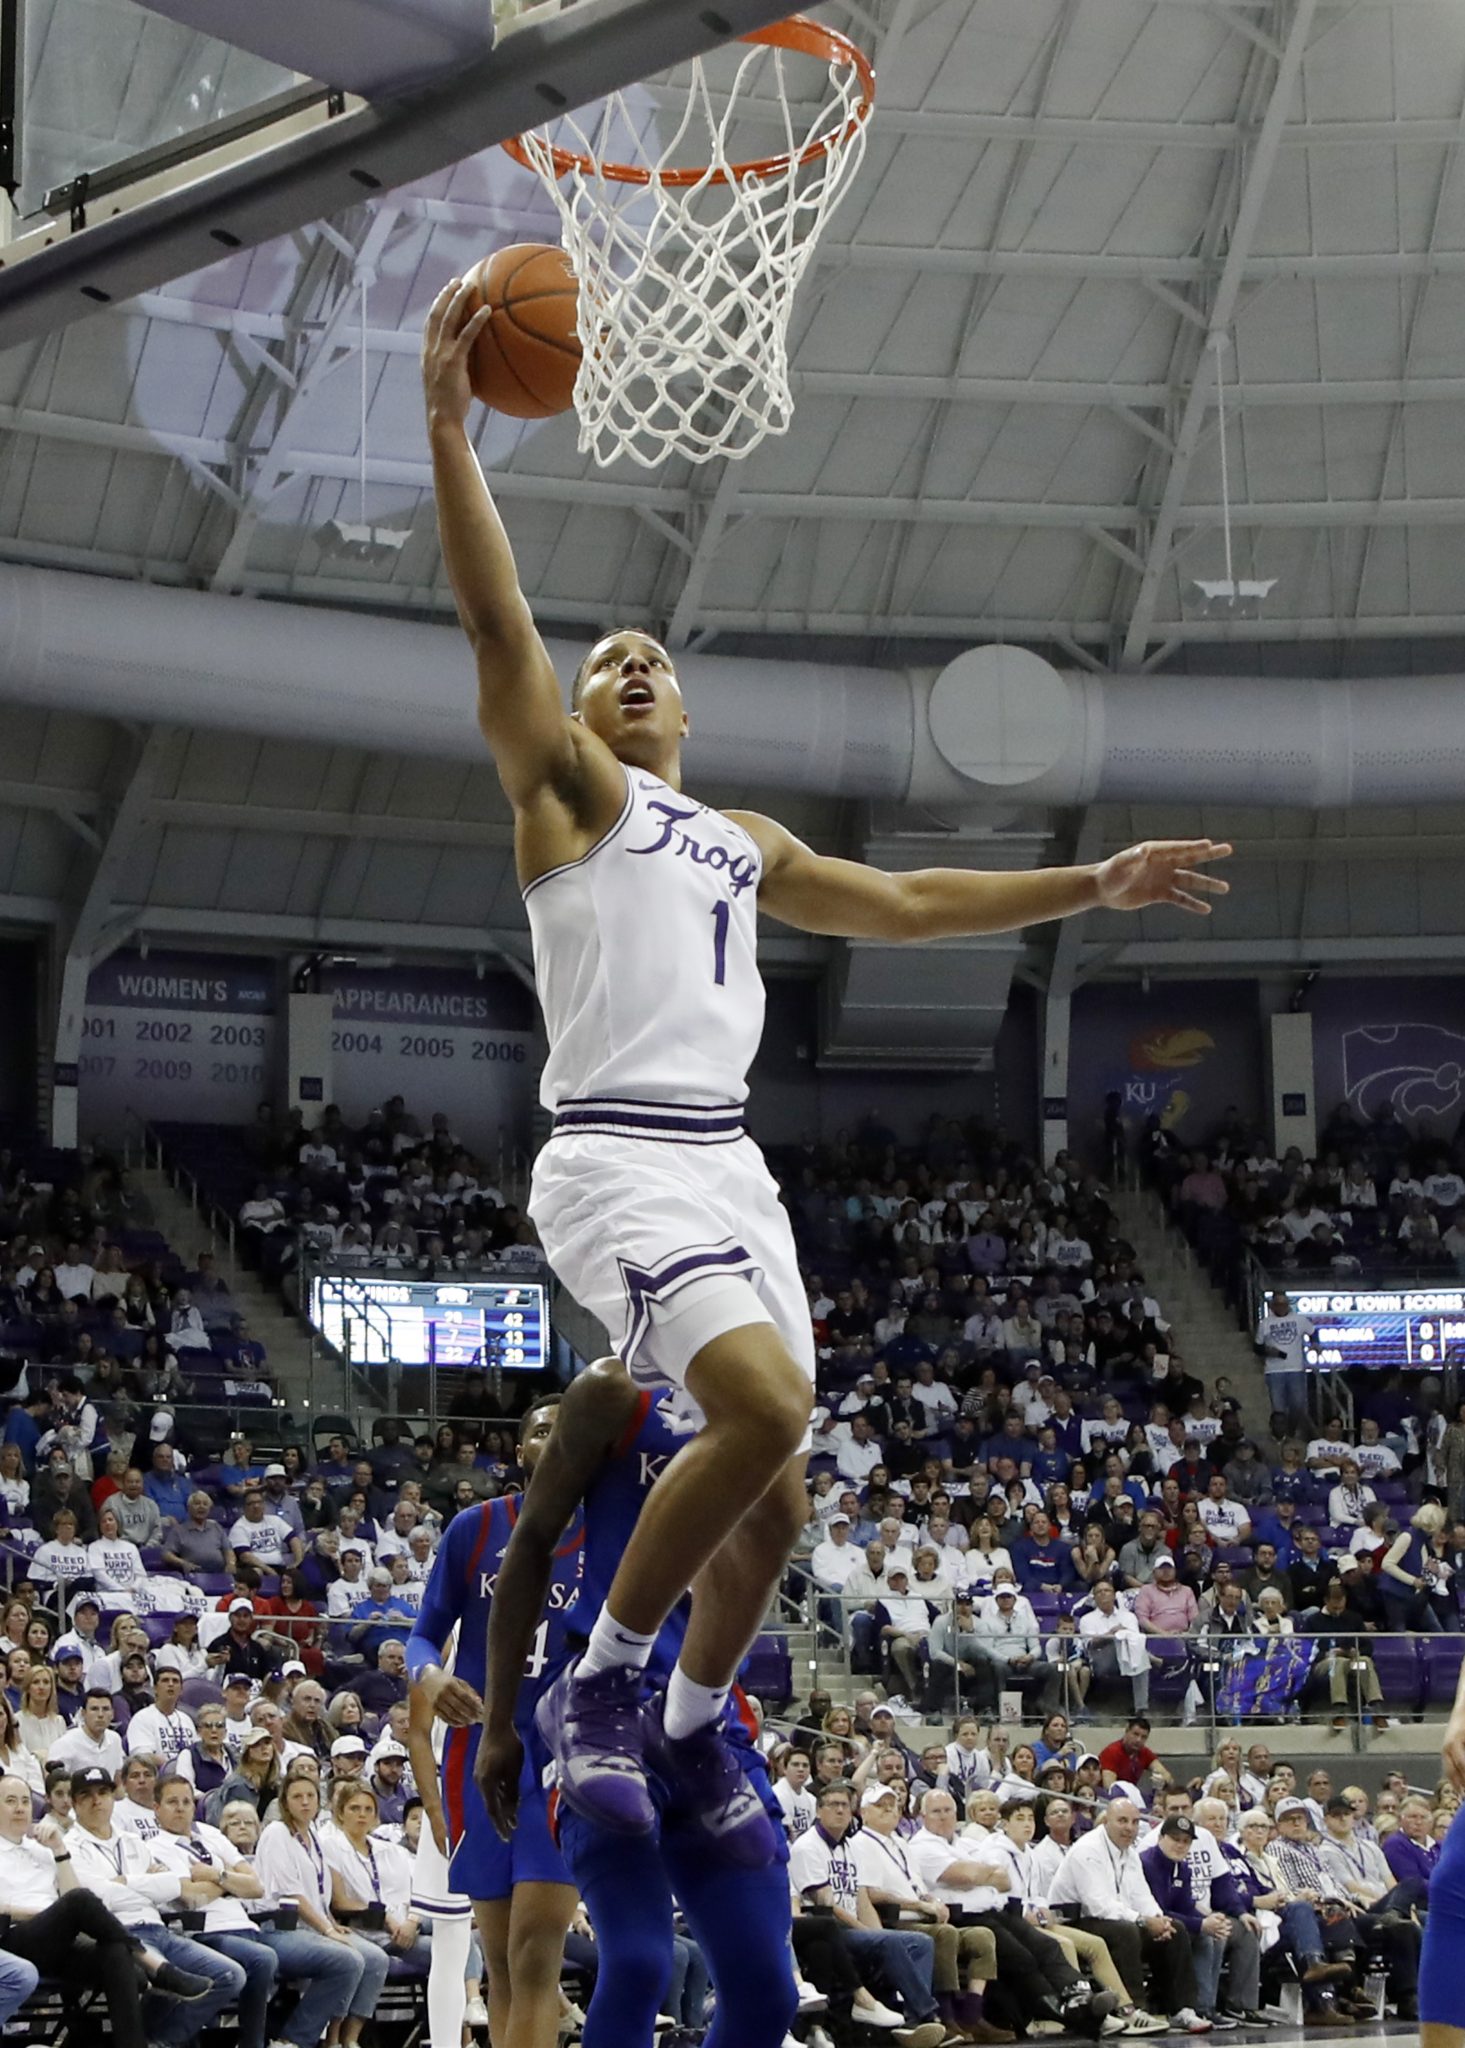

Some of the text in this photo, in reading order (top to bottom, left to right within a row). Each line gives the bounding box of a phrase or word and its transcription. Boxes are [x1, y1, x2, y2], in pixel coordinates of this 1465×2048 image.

[625, 800, 757, 897] Frog
[710, 899, 730, 987] 1
[117, 974, 228, 1002] WOMEN'S
[332, 987, 488, 1019] APPEARANCES
[135, 1021, 193, 1043] 2002
[209, 1025, 266, 1047] 2003
[332, 1032, 383, 1054] 2004
[401, 1036, 455, 1059] 2005
[472, 1041, 526, 1064] 2006
[134, 1058, 193, 1081] 2009
[1126, 1083, 1156, 1104] KU
[1298, 1294, 1463, 1312] OUT OF TOWN SCORES
[504, 1312, 523, 1327] 42
[449, 1329, 524, 1345] 7 13
[1420, 1322, 1433, 1339] 0
[445, 1346, 464, 1361] 22
[1421, 1344, 1434, 1361] 0
[125, 1514, 145, 1524] TCU
[51, 1555, 85, 1564] BLEED
[159, 1727, 193, 1739] BLEED
[134, 1818, 160, 1830] BLE
